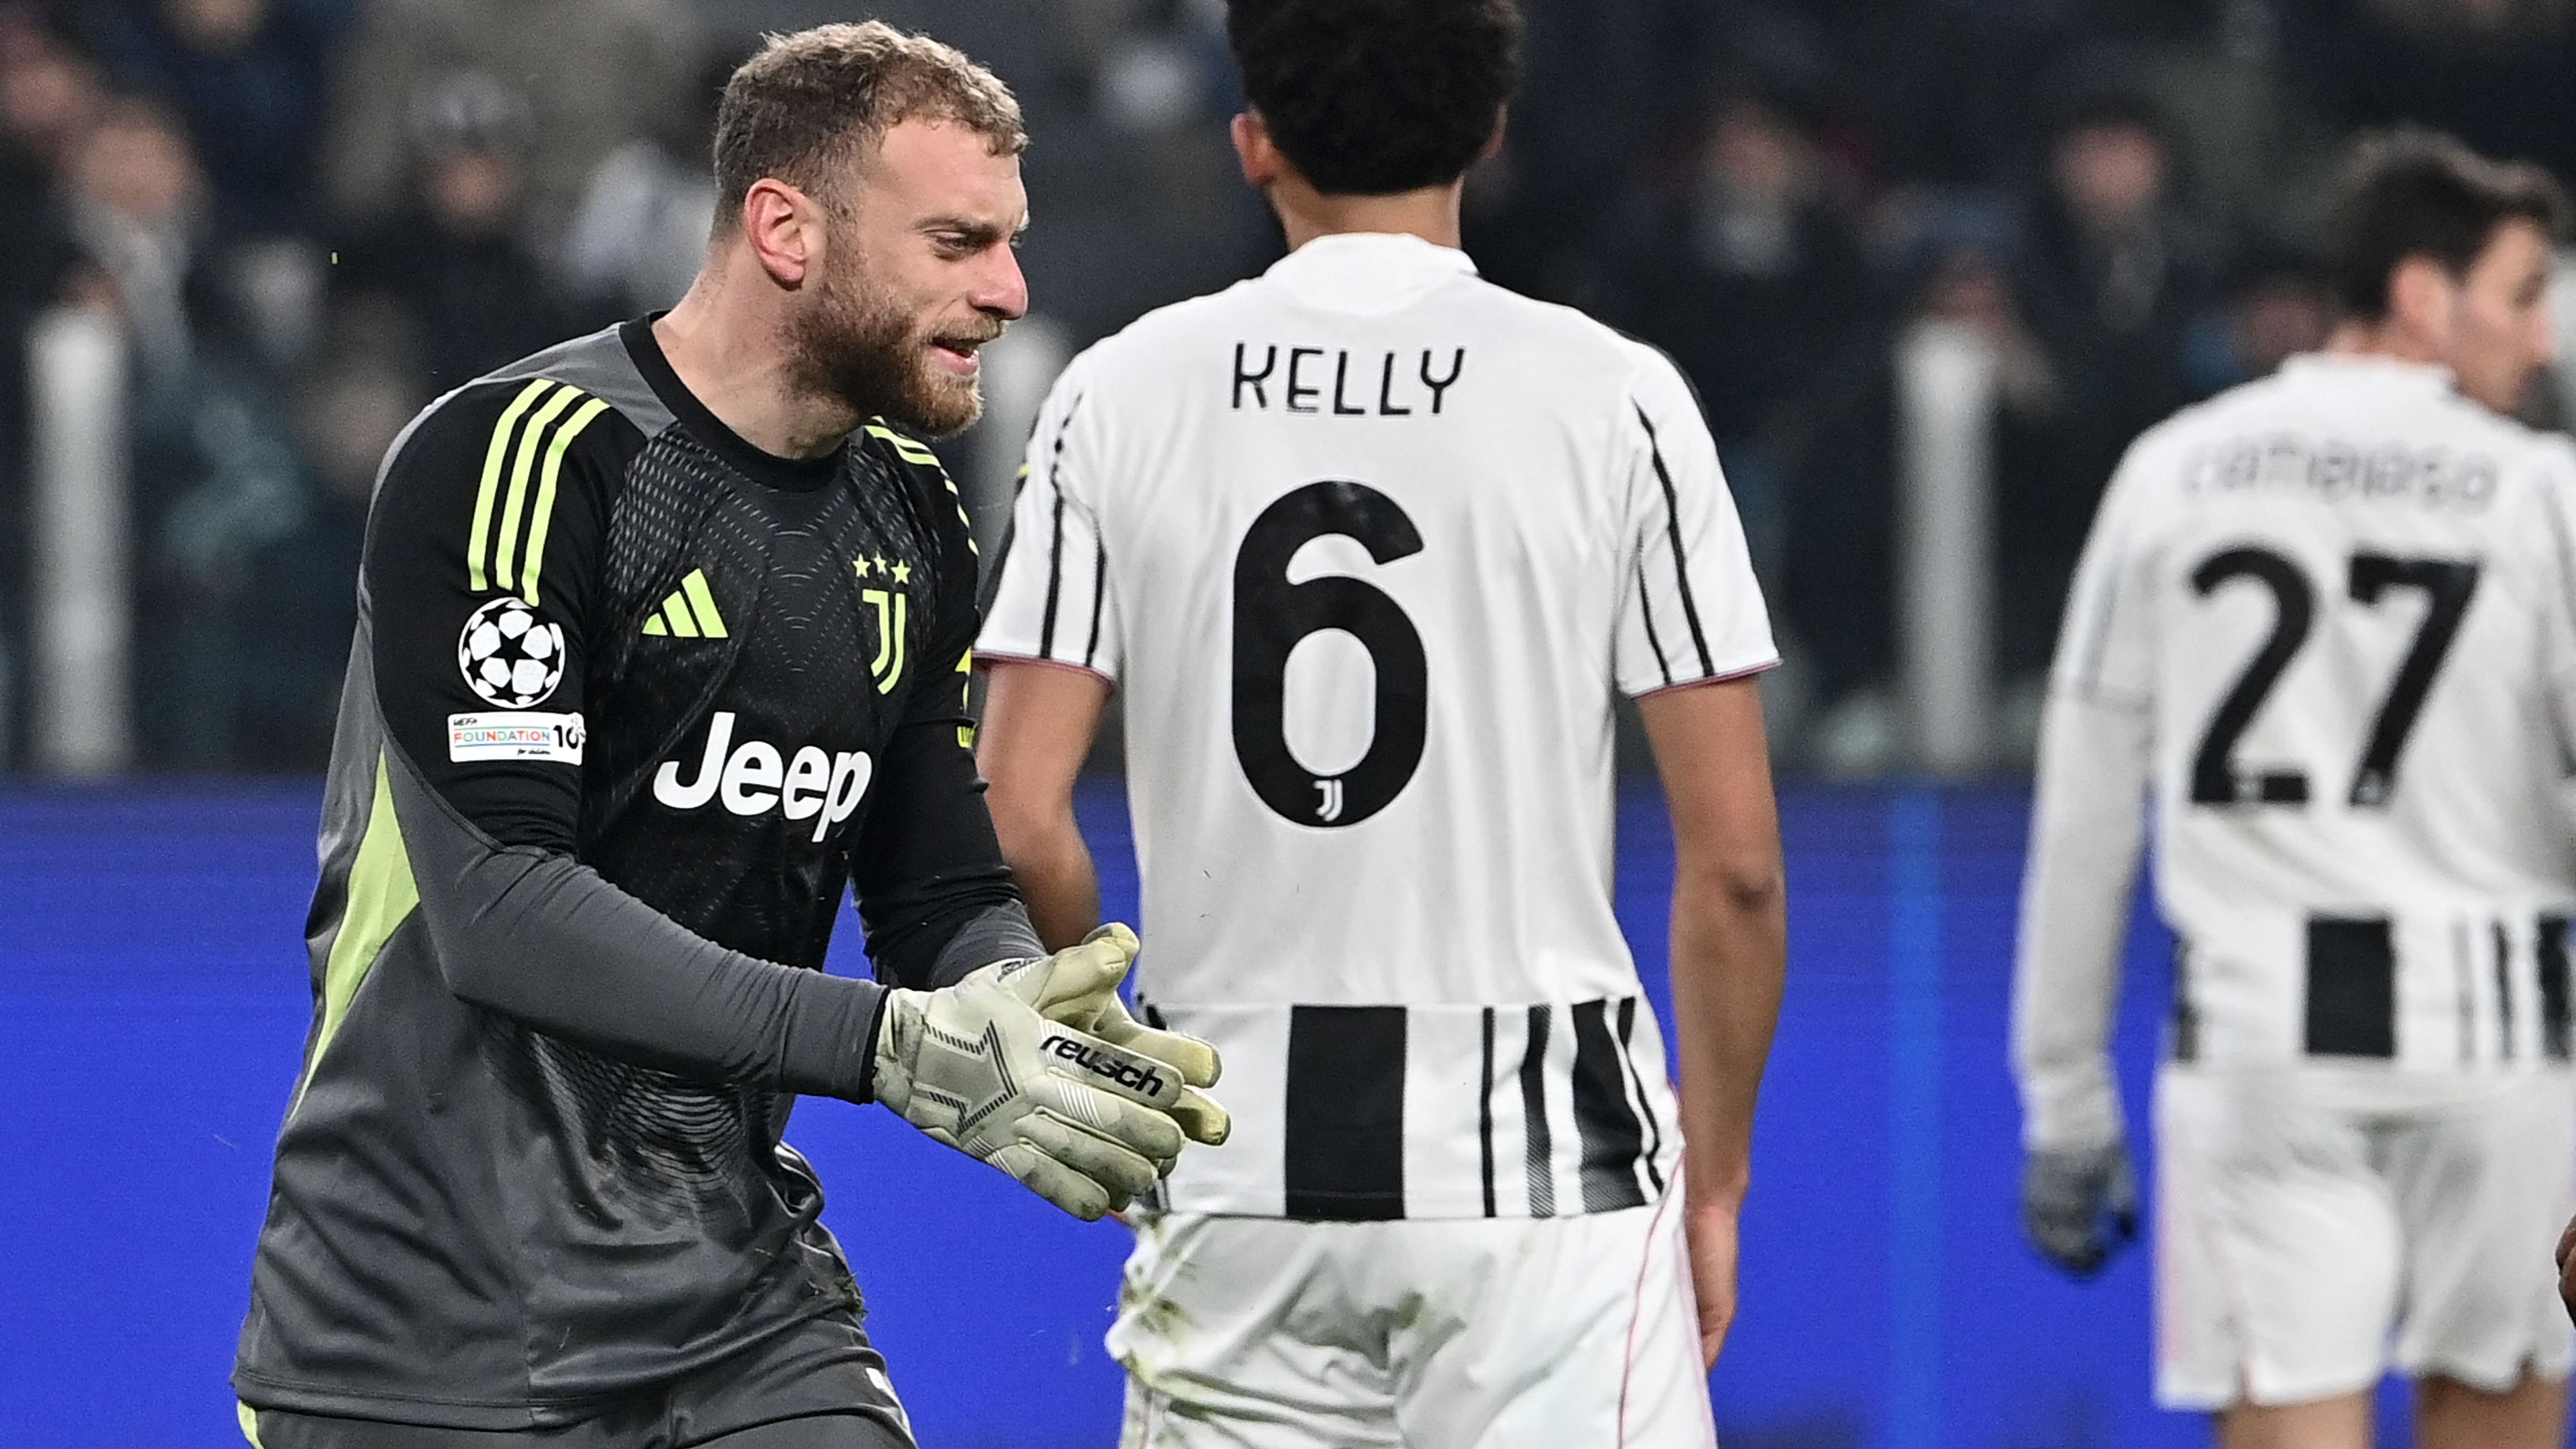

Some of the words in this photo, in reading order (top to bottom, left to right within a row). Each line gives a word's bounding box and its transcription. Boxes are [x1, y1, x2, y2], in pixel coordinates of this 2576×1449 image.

[1231, 342, 1466, 416] KELLY
[1230, 479, 1429, 829] 6
[2184, 540, 2483, 814] 27
[653, 711, 873, 843] Jeep
[1040, 1034, 1164, 1097] reusch
